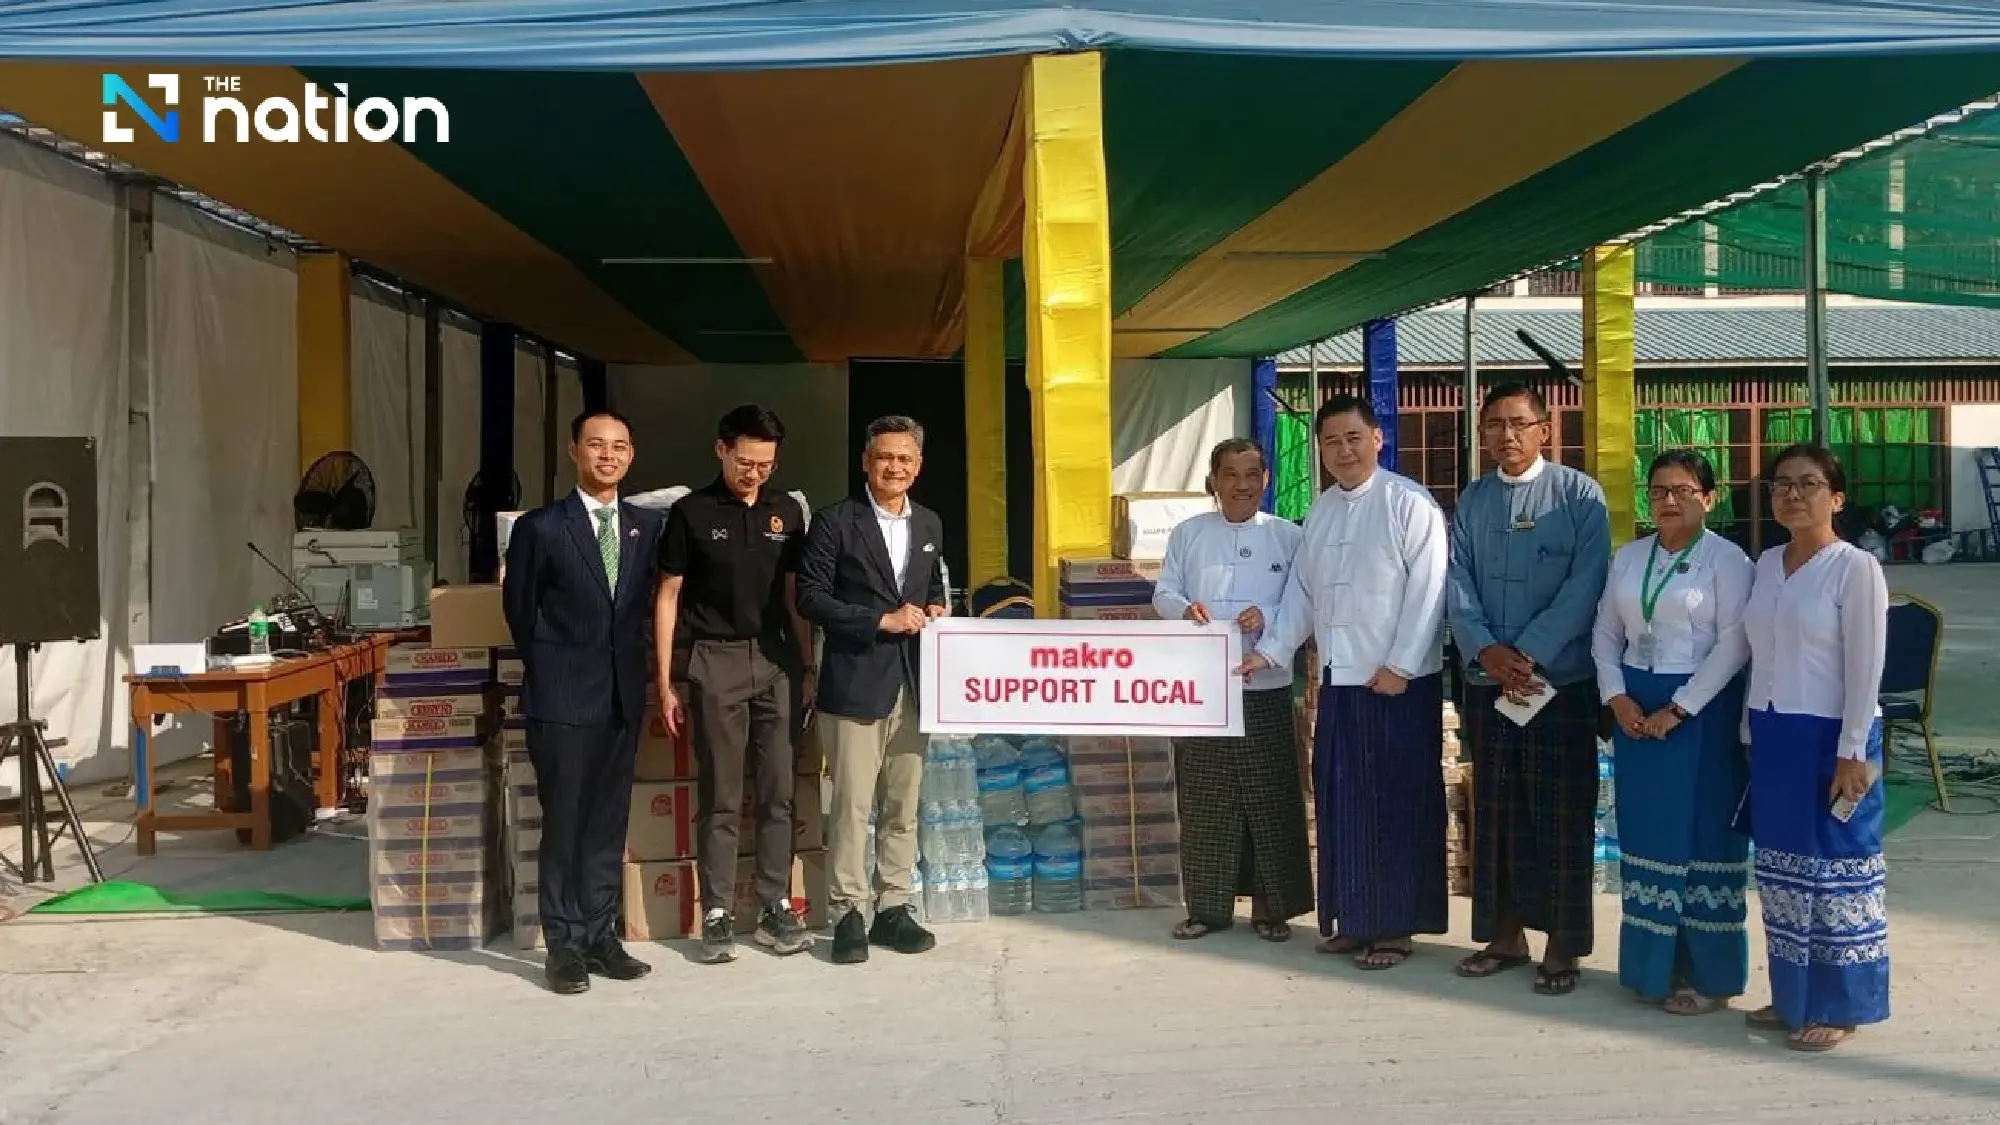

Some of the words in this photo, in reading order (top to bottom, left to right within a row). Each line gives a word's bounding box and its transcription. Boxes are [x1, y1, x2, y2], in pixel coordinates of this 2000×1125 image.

[1031, 642, 1134, 669] makro
[964, 676, 1096, 703] SUPPORT
[1114, 679, 1203, 705] LOCAL
